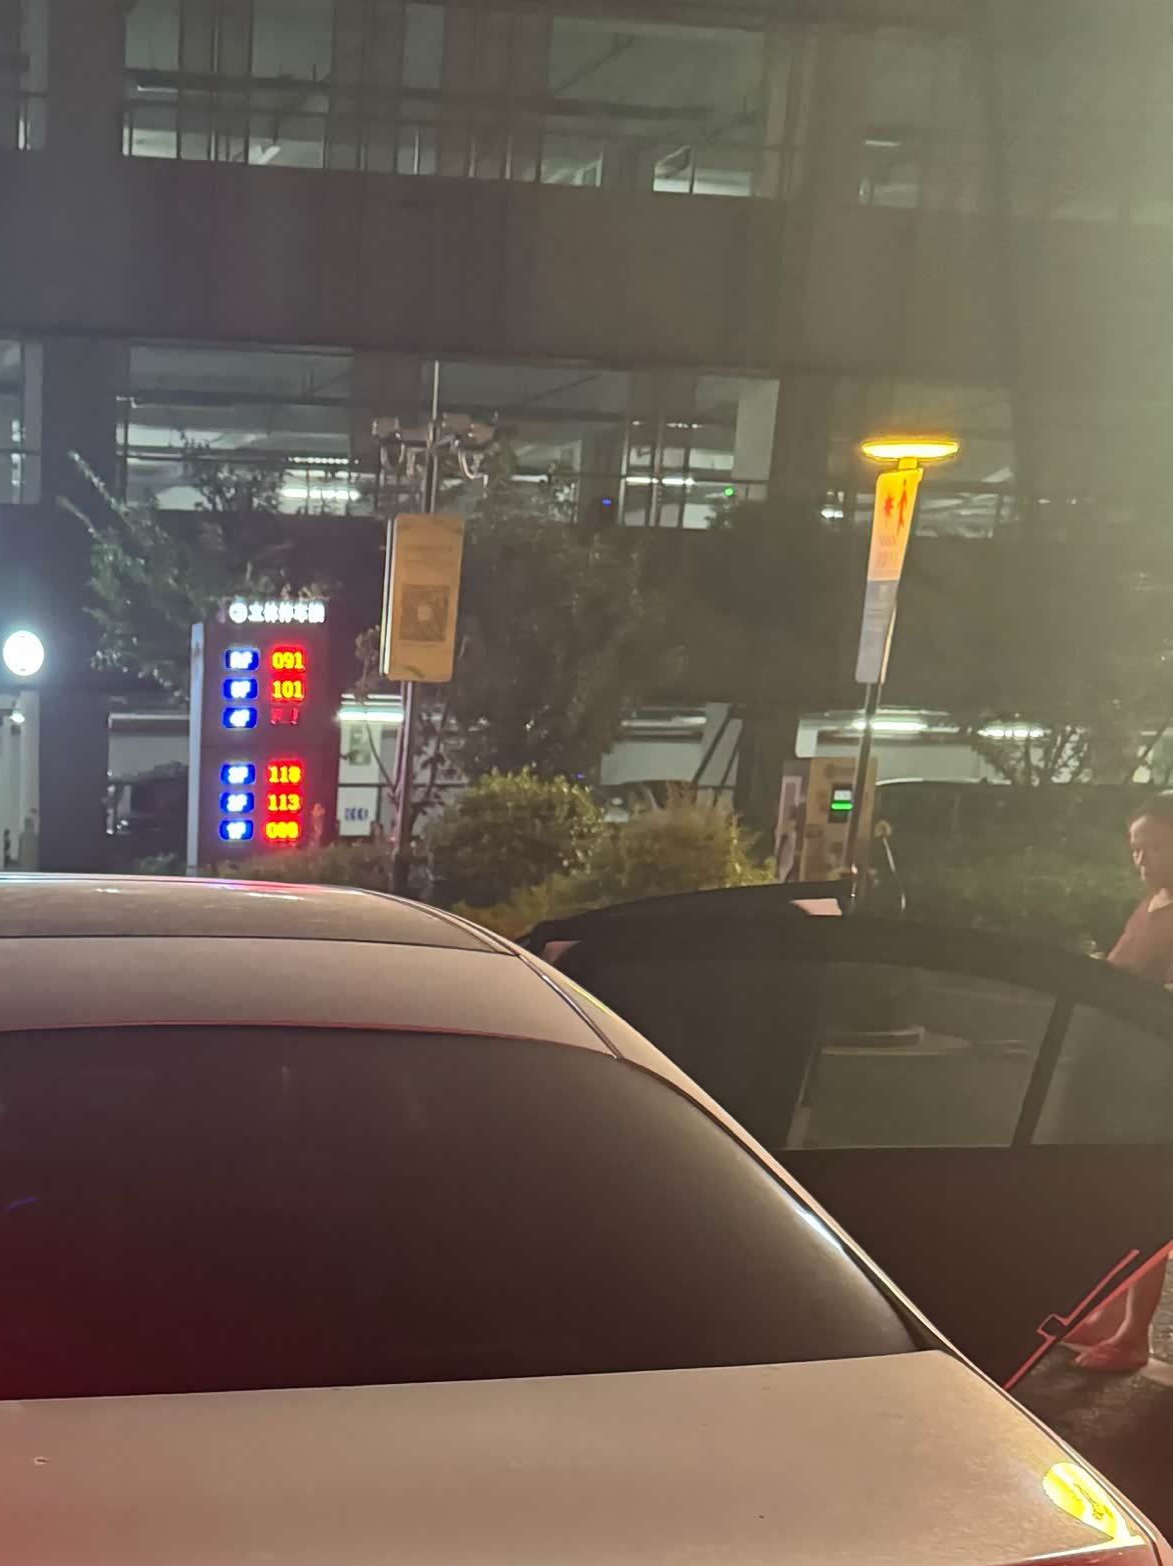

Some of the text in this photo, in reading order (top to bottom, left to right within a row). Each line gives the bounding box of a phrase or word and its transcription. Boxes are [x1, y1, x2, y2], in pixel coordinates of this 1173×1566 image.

[272, 651, 305, 670] 091
[272, 680, 303, 699] 101
[267, 794, 301, 812] 113
